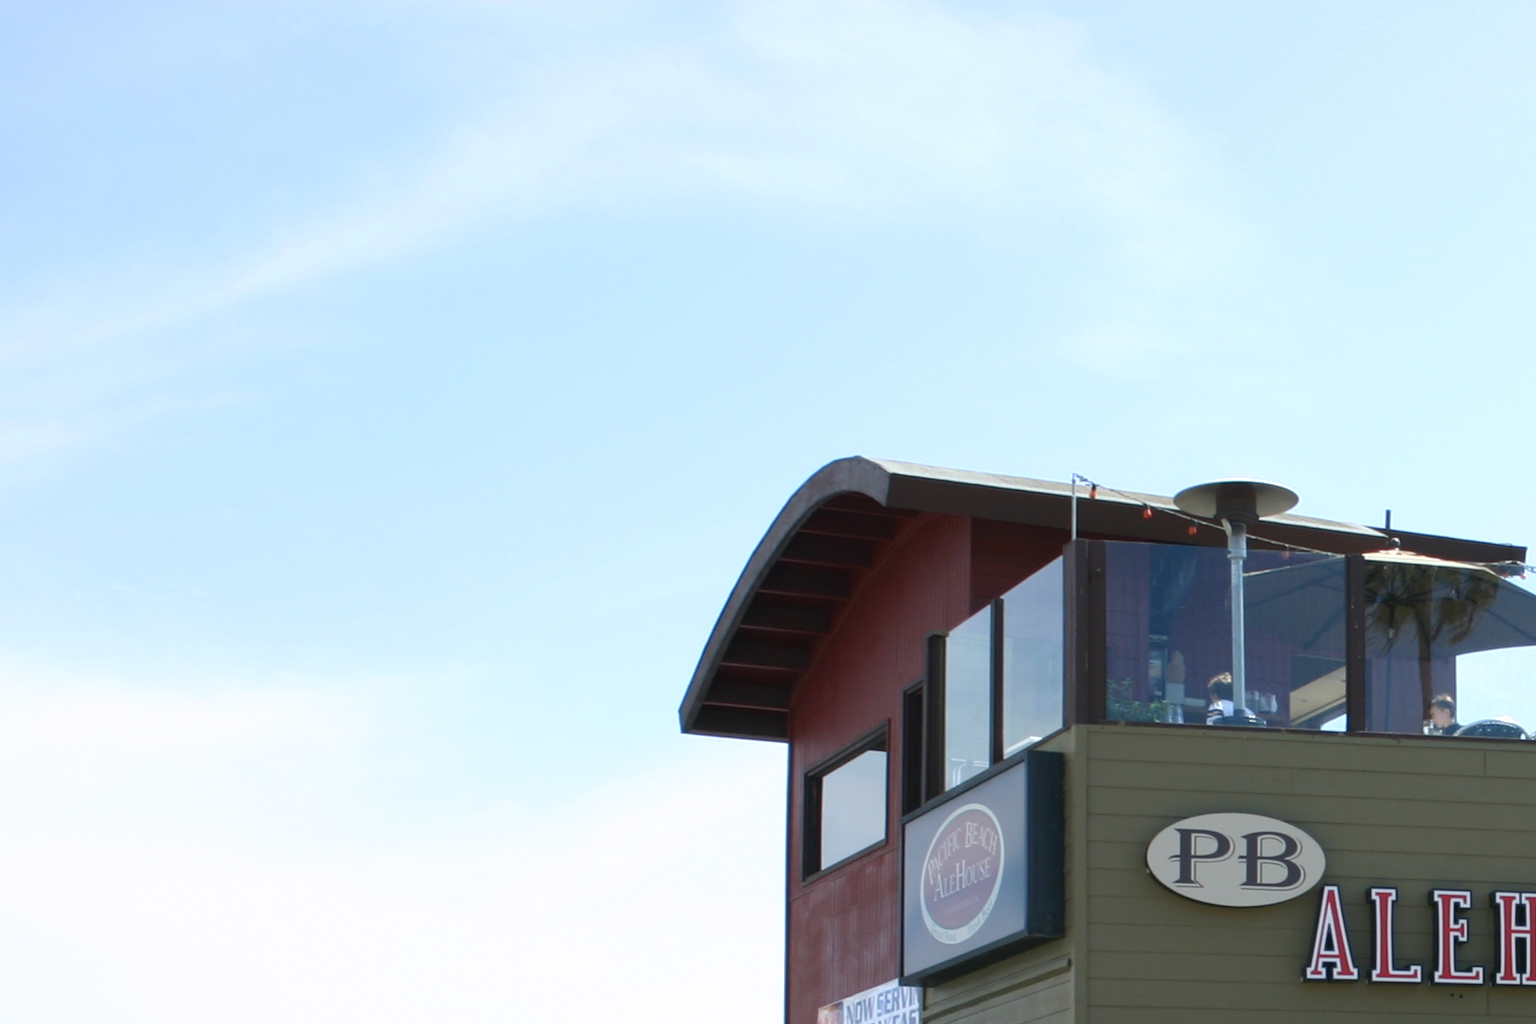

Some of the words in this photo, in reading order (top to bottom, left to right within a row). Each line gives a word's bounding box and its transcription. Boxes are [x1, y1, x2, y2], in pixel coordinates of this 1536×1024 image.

[927, 828, 961, 885] PACIFIC
[965, 821, 999, 856] BEACH
[1168, 827, 1307, 892] PB
[876, 987, 921, 1017] SERVIN
